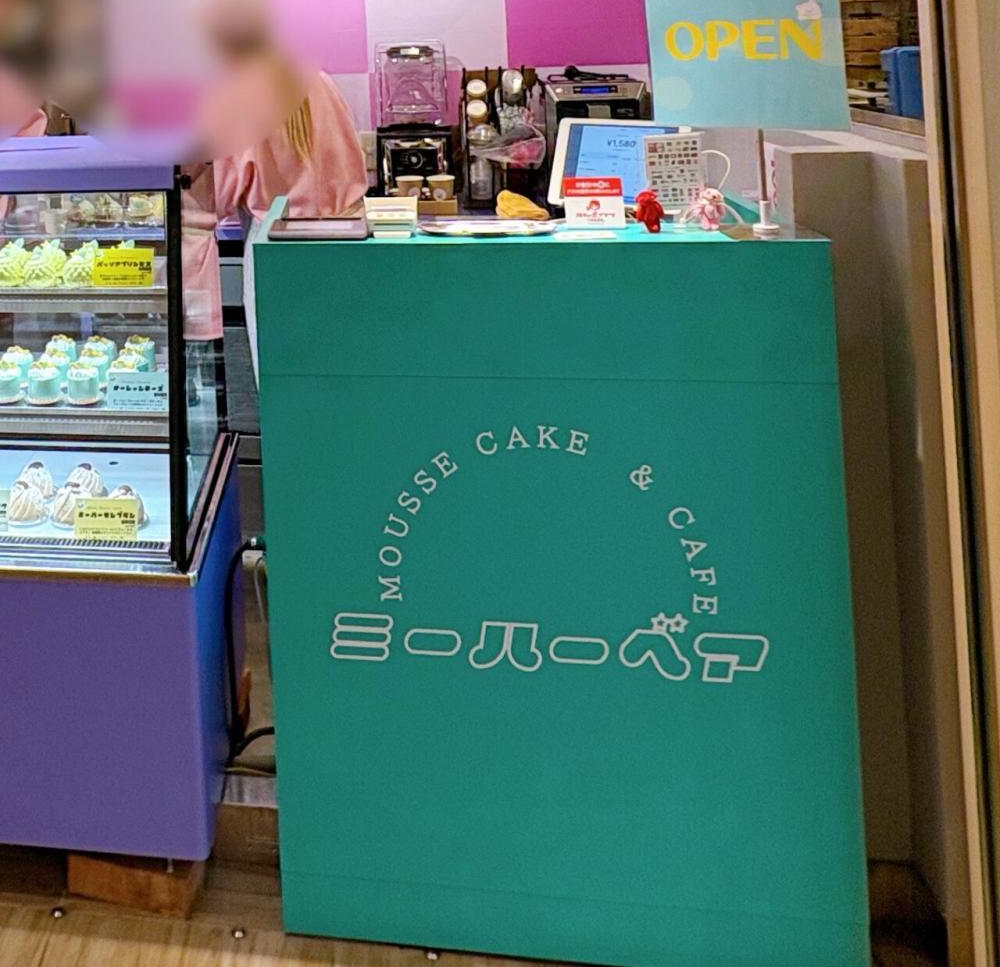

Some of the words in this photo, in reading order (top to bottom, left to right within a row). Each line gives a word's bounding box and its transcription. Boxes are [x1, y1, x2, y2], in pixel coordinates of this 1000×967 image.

[664, 18, 825, 61] OPEN
[378, 451, 458, 602] MOUSSE
[475, 425, 589, 456] CAKE
[629, 464, 654, 491] &
[668, 507, 718, 615] CAFE
[330, 612, 769, 683] ミーハーベア
